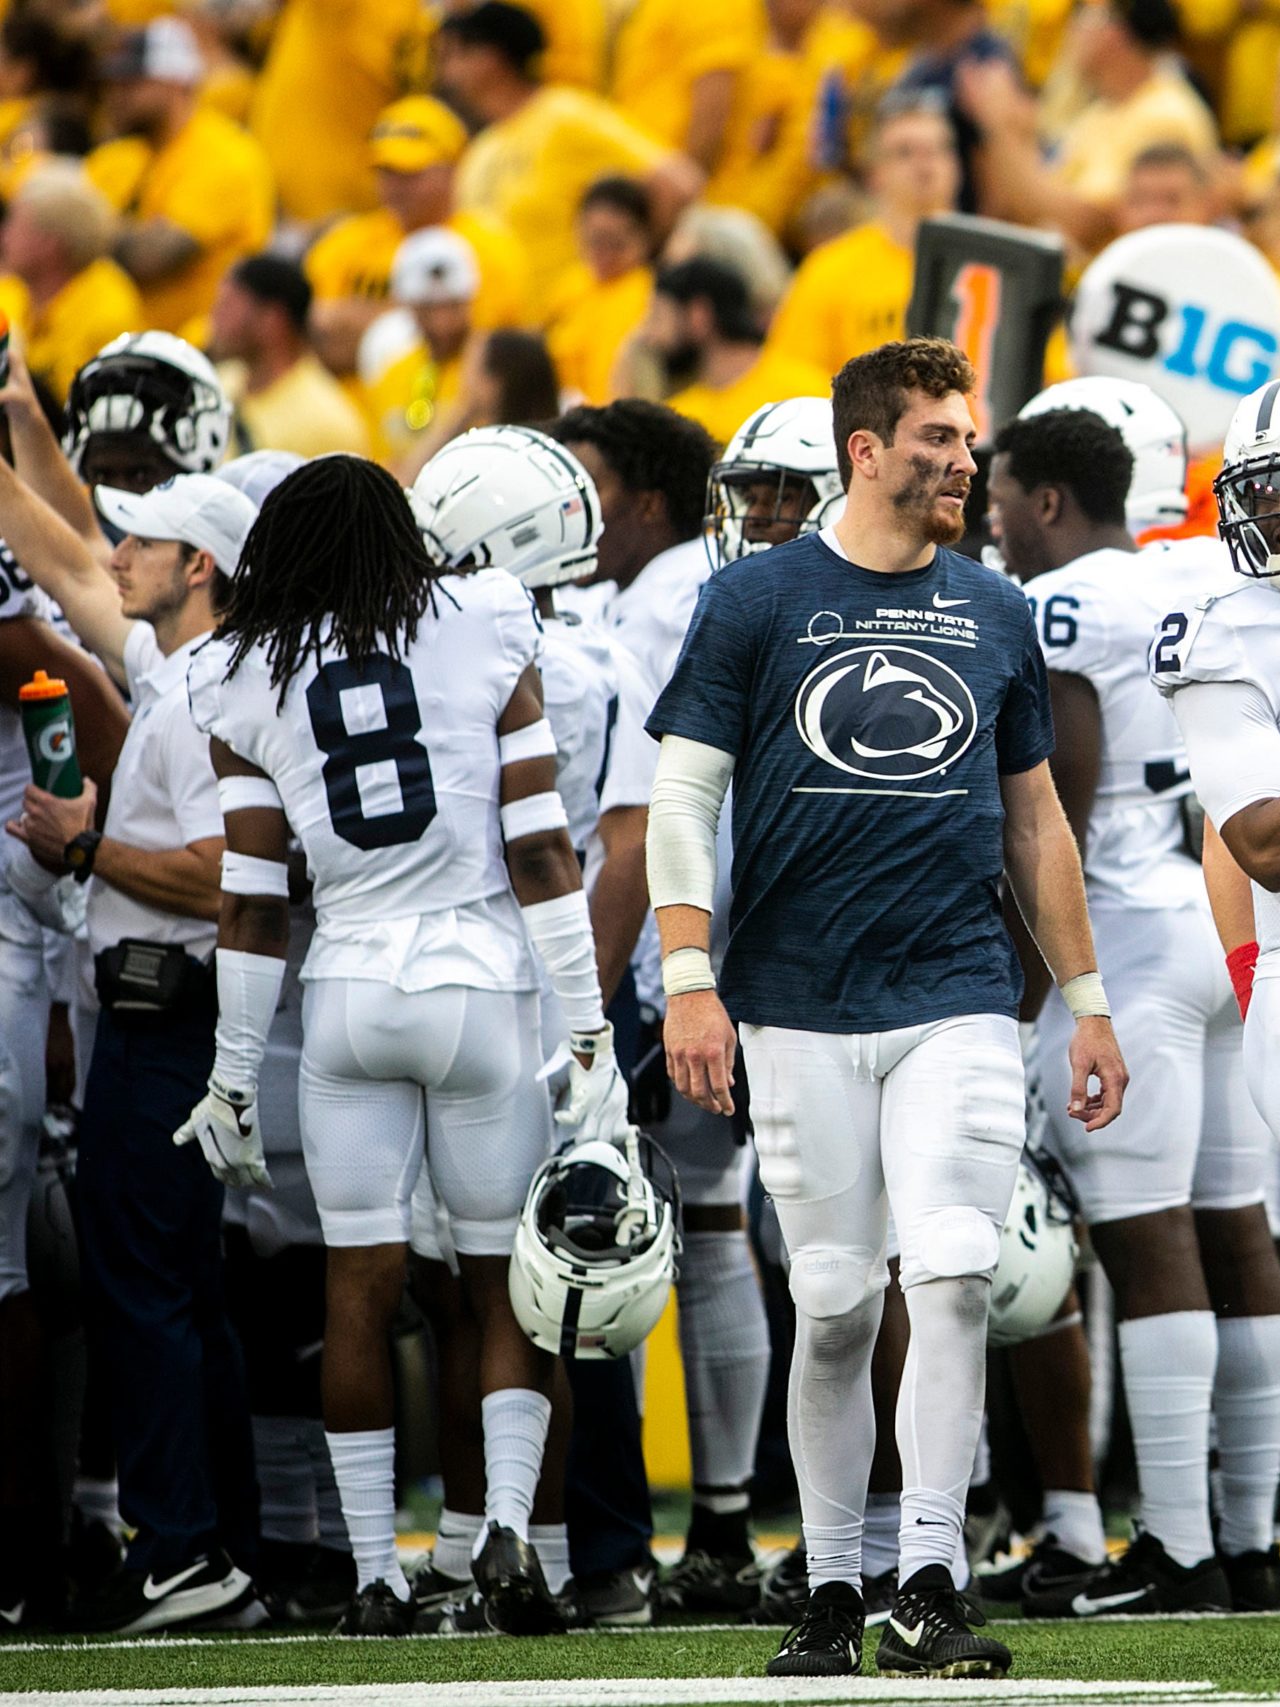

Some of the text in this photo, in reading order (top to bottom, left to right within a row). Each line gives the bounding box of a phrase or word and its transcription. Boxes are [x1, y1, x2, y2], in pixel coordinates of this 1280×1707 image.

[856, 620, 928, 632] NITTANY
[876, 608, 923, 620] PENN
[1155, 612, 1189, 673] 2
[39, 720, 73, 762] G
[305, 651, 438, 851] 8
